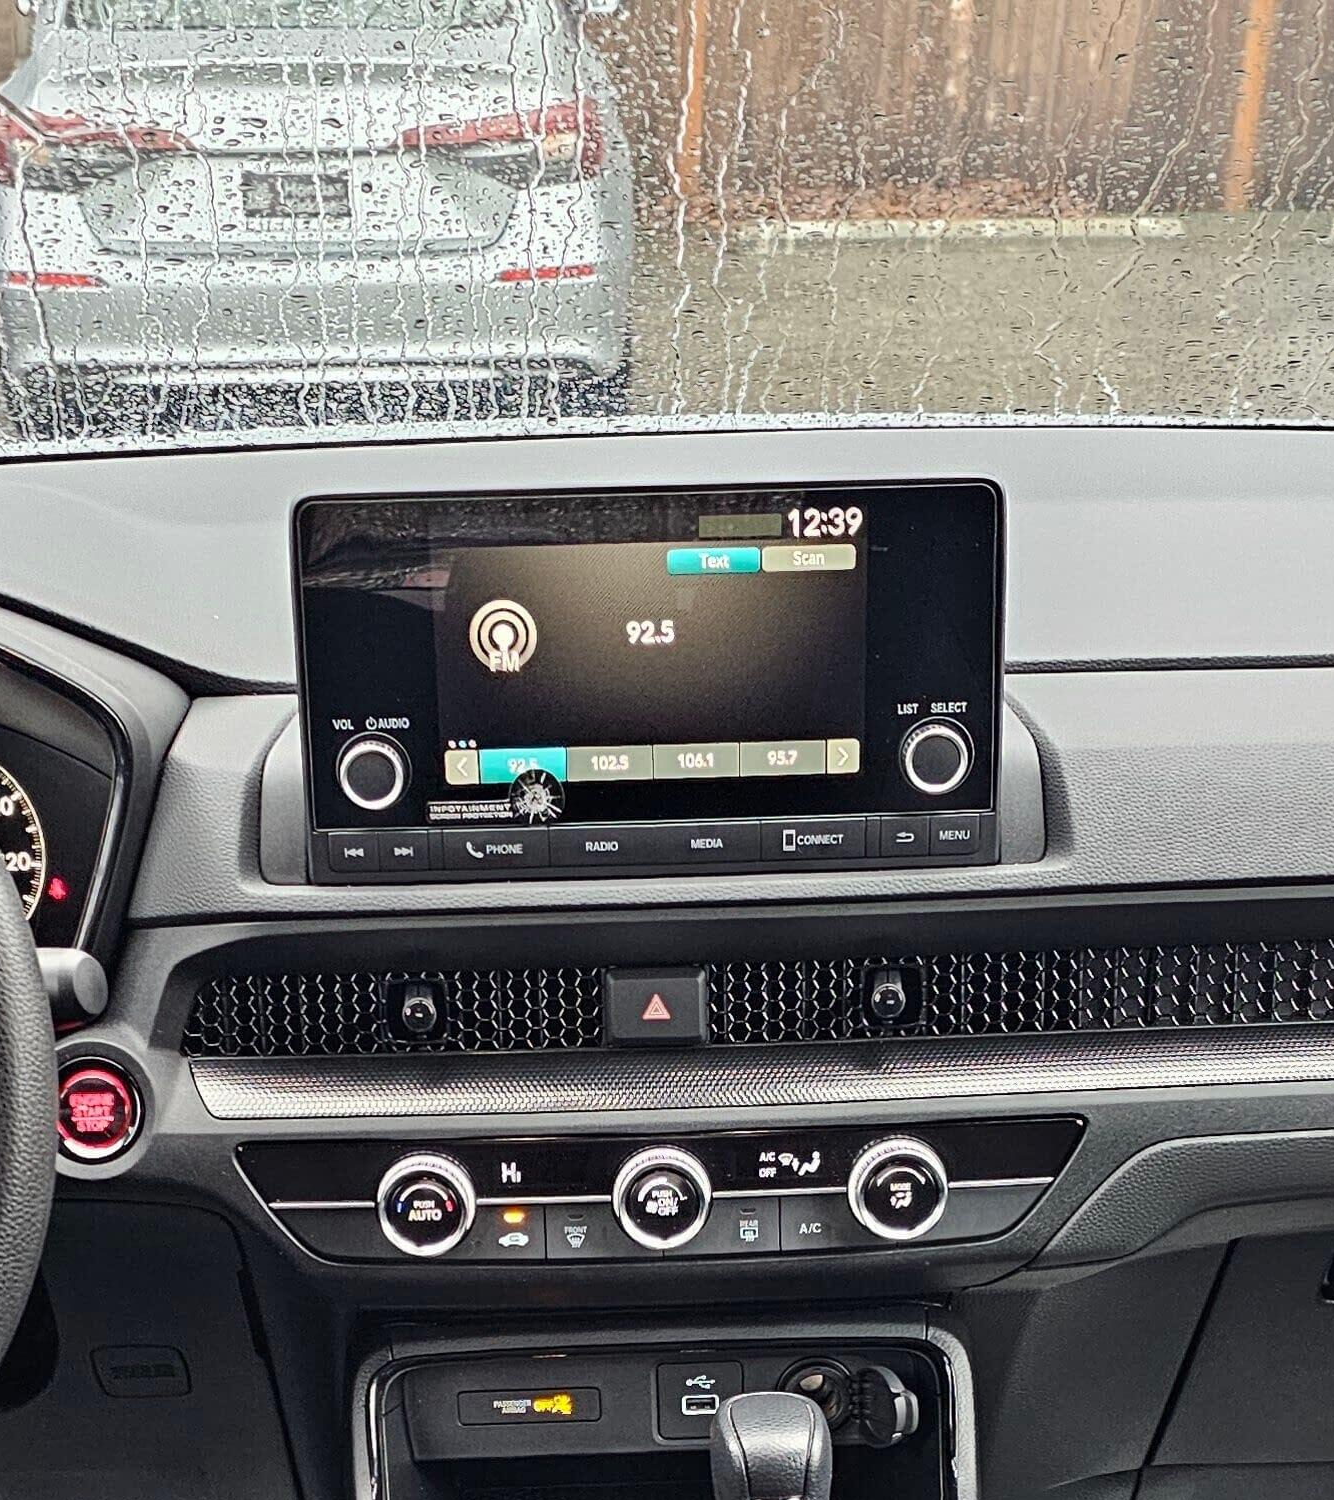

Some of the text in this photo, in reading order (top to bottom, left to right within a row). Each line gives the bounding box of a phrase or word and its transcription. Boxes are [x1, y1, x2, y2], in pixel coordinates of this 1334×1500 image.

[787, 506, 863, 538] 12:39
[699, 553, 729, 569] Text
[793, 551, 825, 566] Scan
[626, 619, 675, 644] 92.5
[489, 650, 520, 672] FM
[897, 702, 967, 715] LIST SELECT
[332, 717, 410, 730] VOL AUDIO
[591, 755, 629, 771] 102.5
[677, 752, 714, 768] 106.1
[767, 750, 797, 766] 95.7
[797, 834, 844, 846] CONNECT
[939, 830, 970, 841] MENU
[486, 844, 523, 855] PHONE
[585, 841, 619, 852] RADIO
[690, 838, 723, 849] MEDIA
[72, 1105, 111, 1117] START
[759, 1151, 776, 1162] A/C
[413, 1201, 435, 1209] PUSH
[408, 1209, 442, 1222] AUTO
[564, 1226, 587, 1234] FRONT
[799, 1223, 821, 1234] A/C
